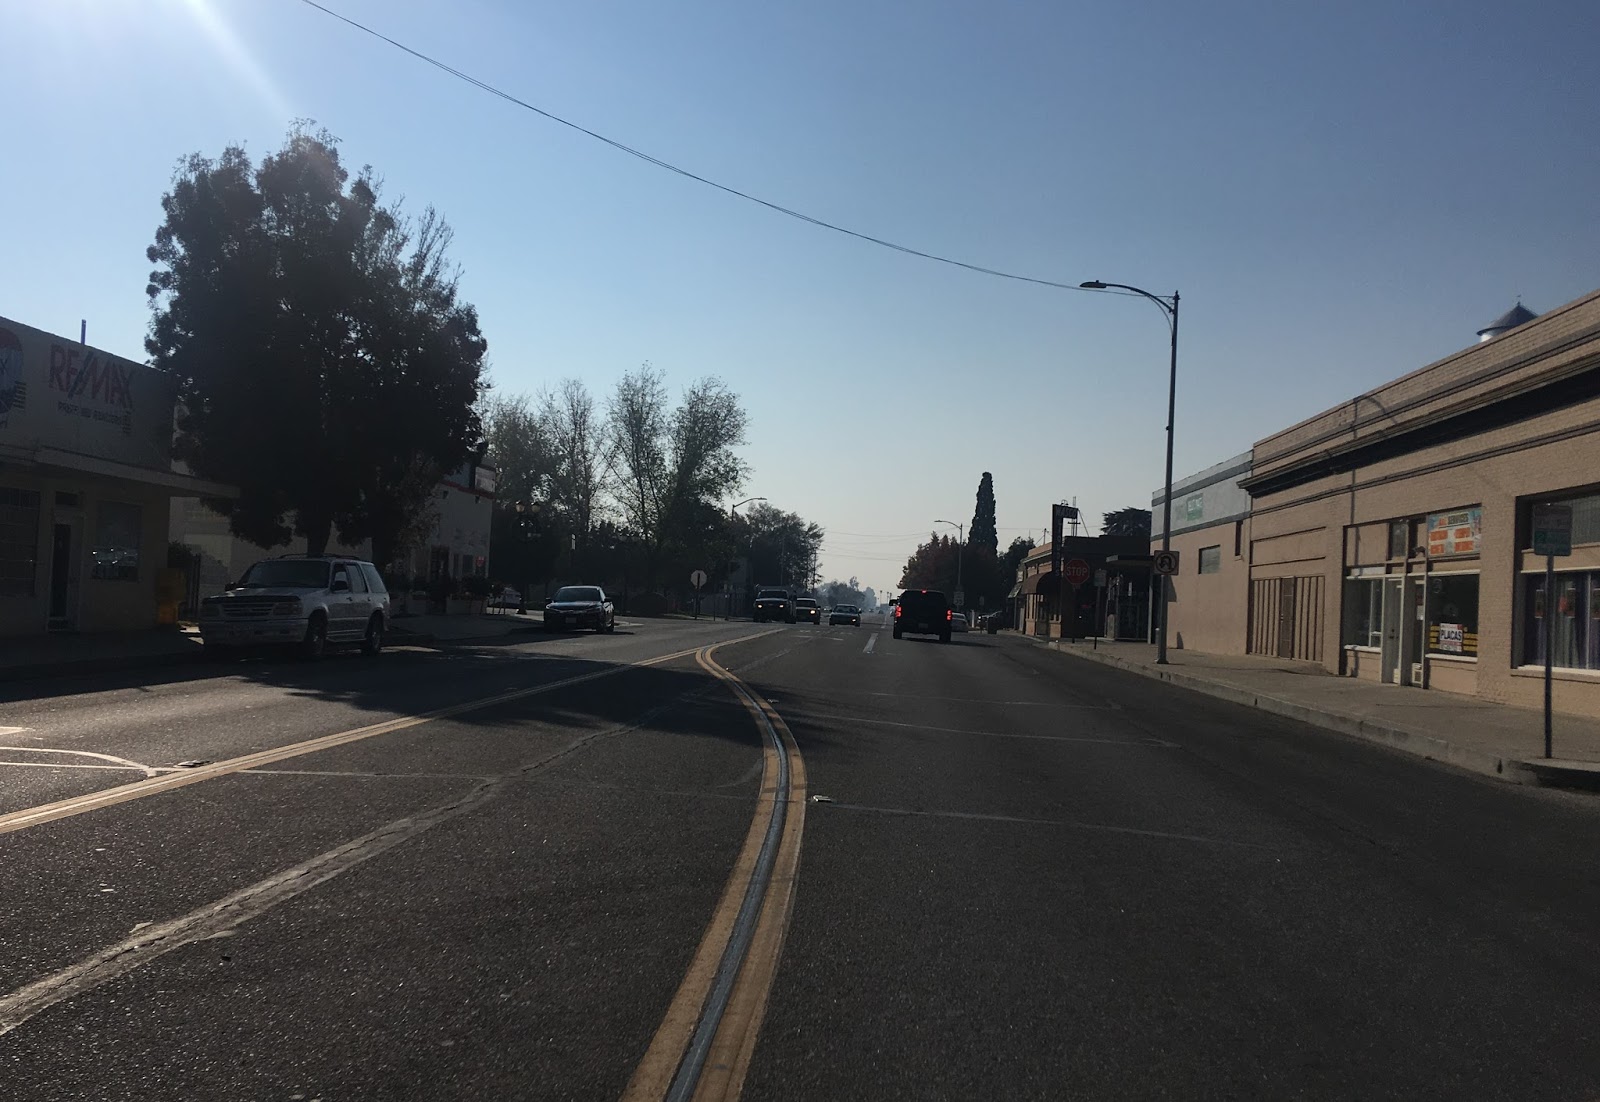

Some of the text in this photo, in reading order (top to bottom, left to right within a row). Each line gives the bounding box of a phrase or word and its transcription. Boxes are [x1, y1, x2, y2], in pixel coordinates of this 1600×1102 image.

[49, 344, 134, 410] RE/MAX
[1066, 566, 1088, 577] STOP
[1441, 630, 1462, 641] PLACAS
